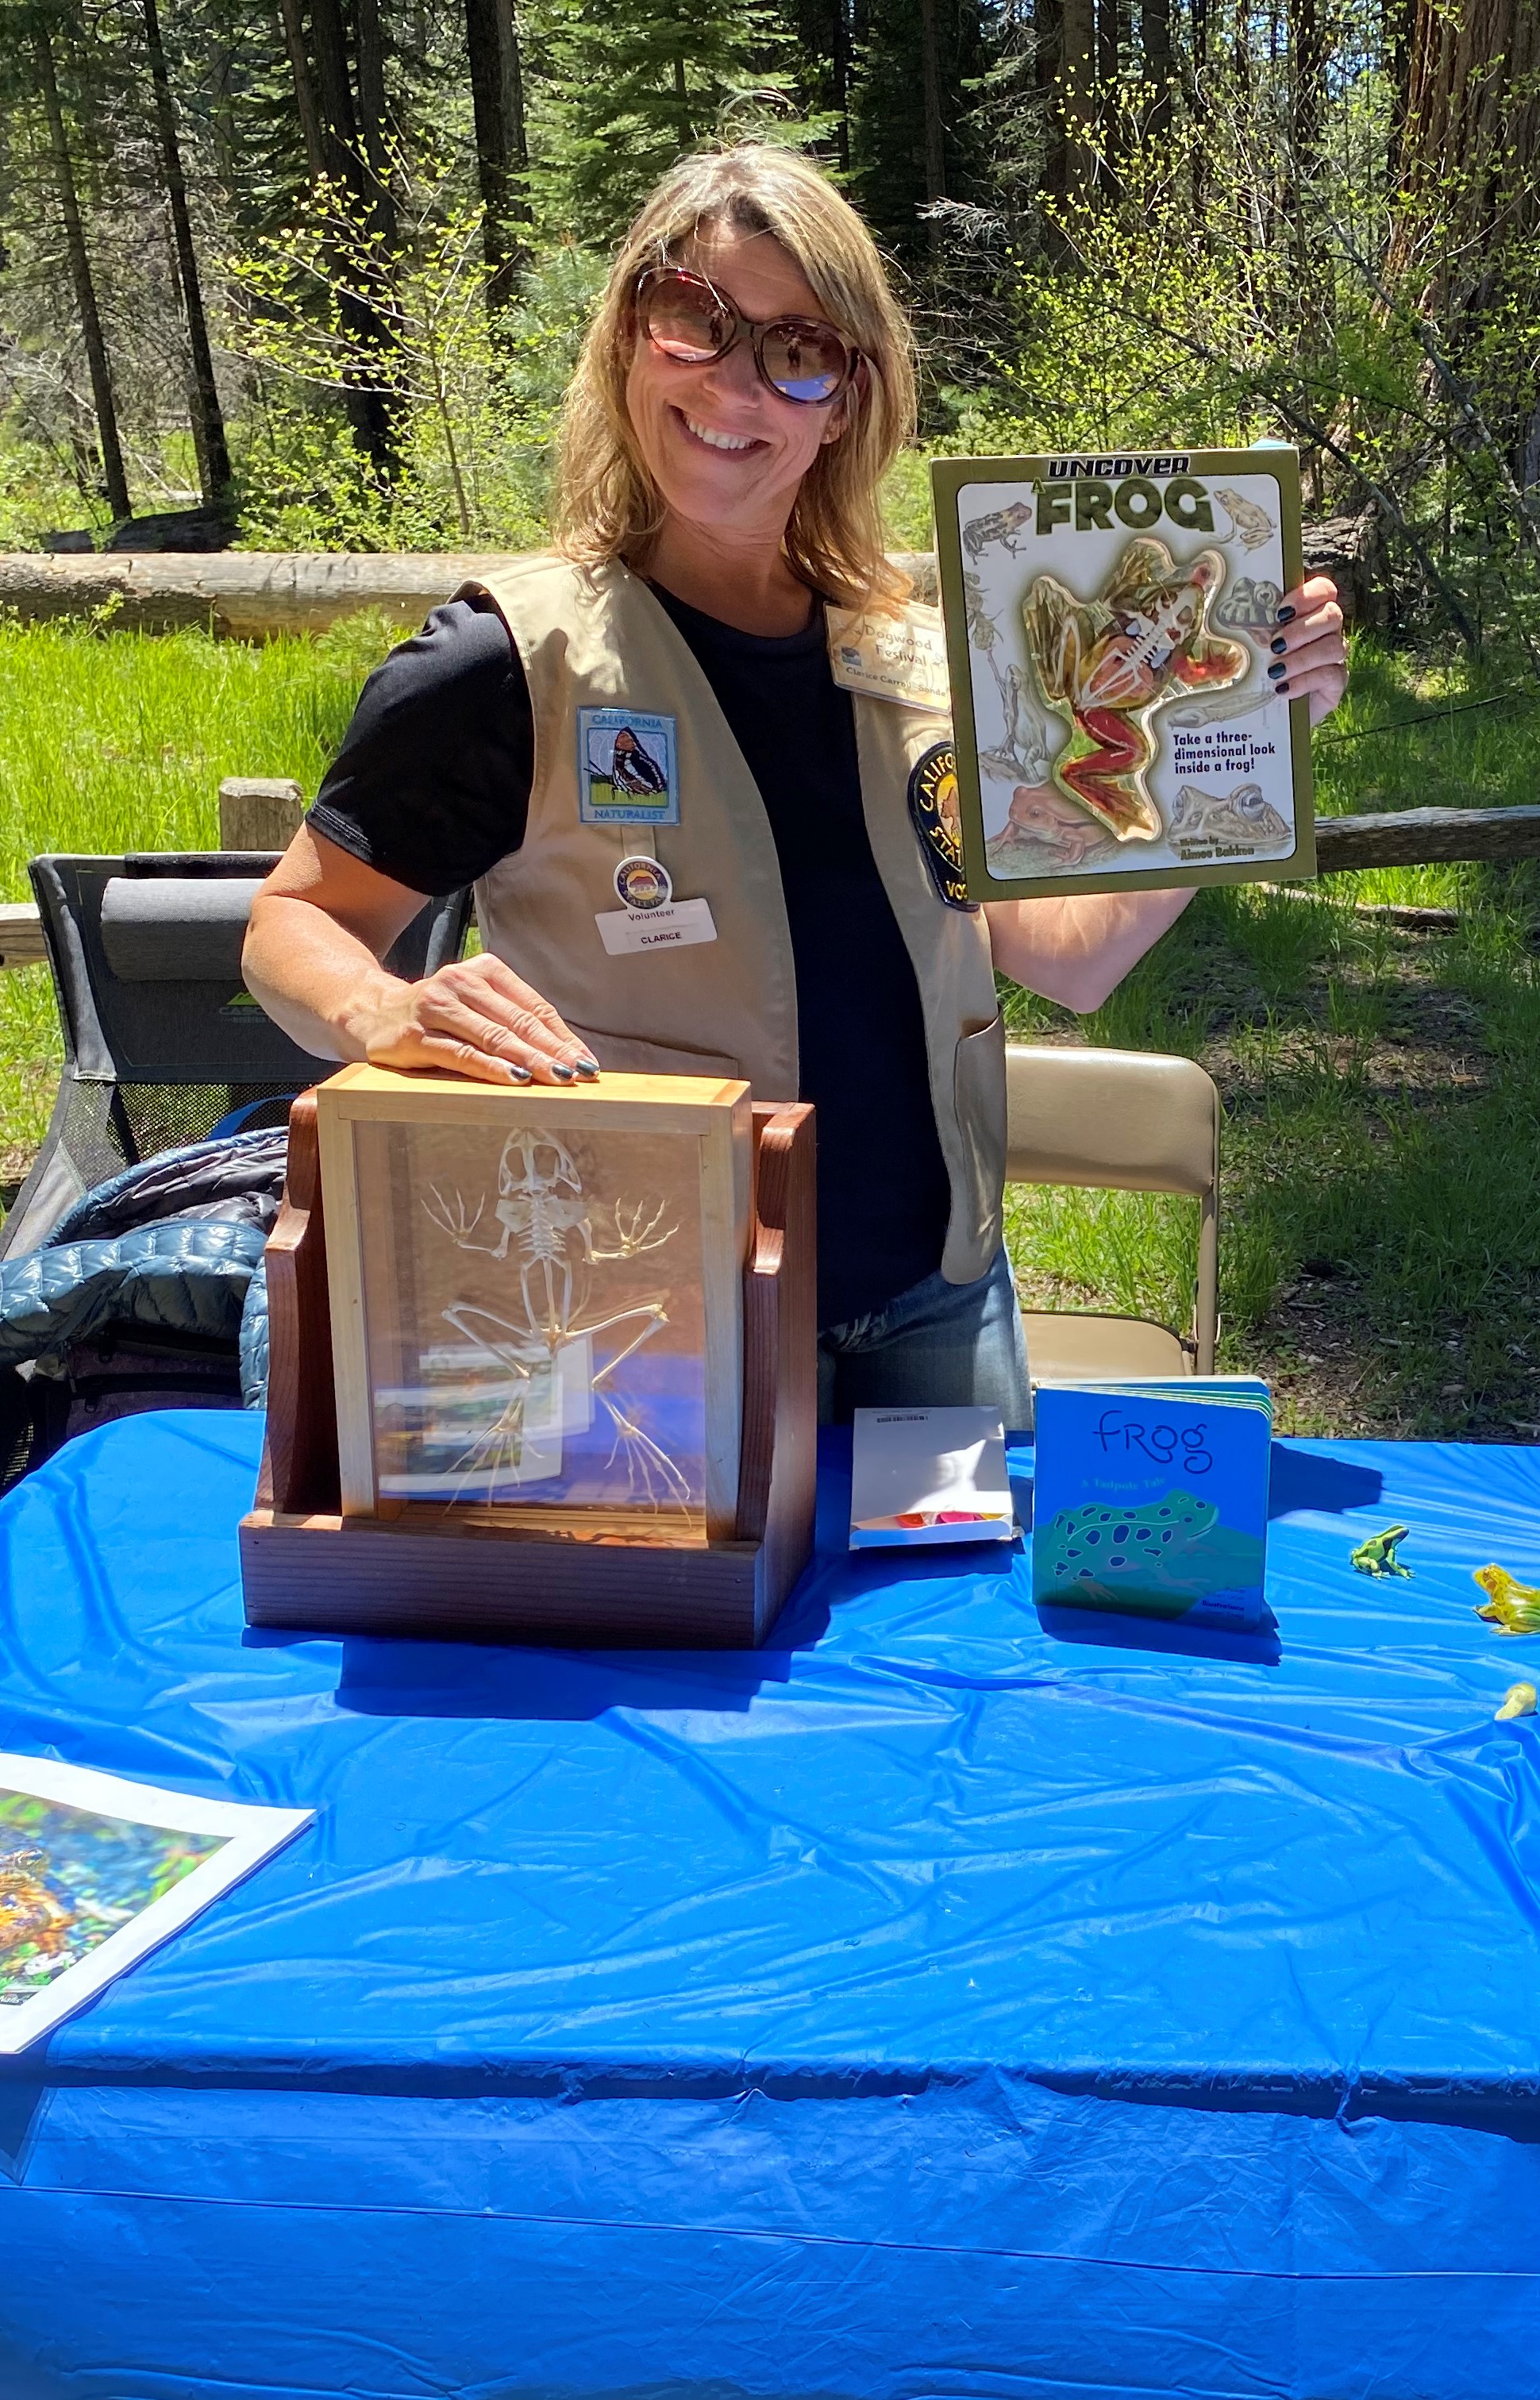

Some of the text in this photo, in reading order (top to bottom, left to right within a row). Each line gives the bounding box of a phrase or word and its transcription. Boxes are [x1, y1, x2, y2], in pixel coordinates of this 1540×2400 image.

[1049, 456, 1191, 477] UNCOVER
[1031, 476, 1046, 494] A
[1036, 476, 1215, 536] FROG
[866, 624, 932, 651] Dogwood
[875, 644, 927, 666] Festival
[846, 667, 878, 680] Clarice
[592, 715, 663, 728] CALIFORNIA
[1173, 730, 1253, 745] Take a three-
[1174, 742, 1276, 760] dimensional look
[1175, 757, 1255, 774] inside a frog!
[594, 810, 664, 819] NATURALIST
[628, 909, 676, 922] Volunteer
[641, 932, 683, 944] CLARICE
